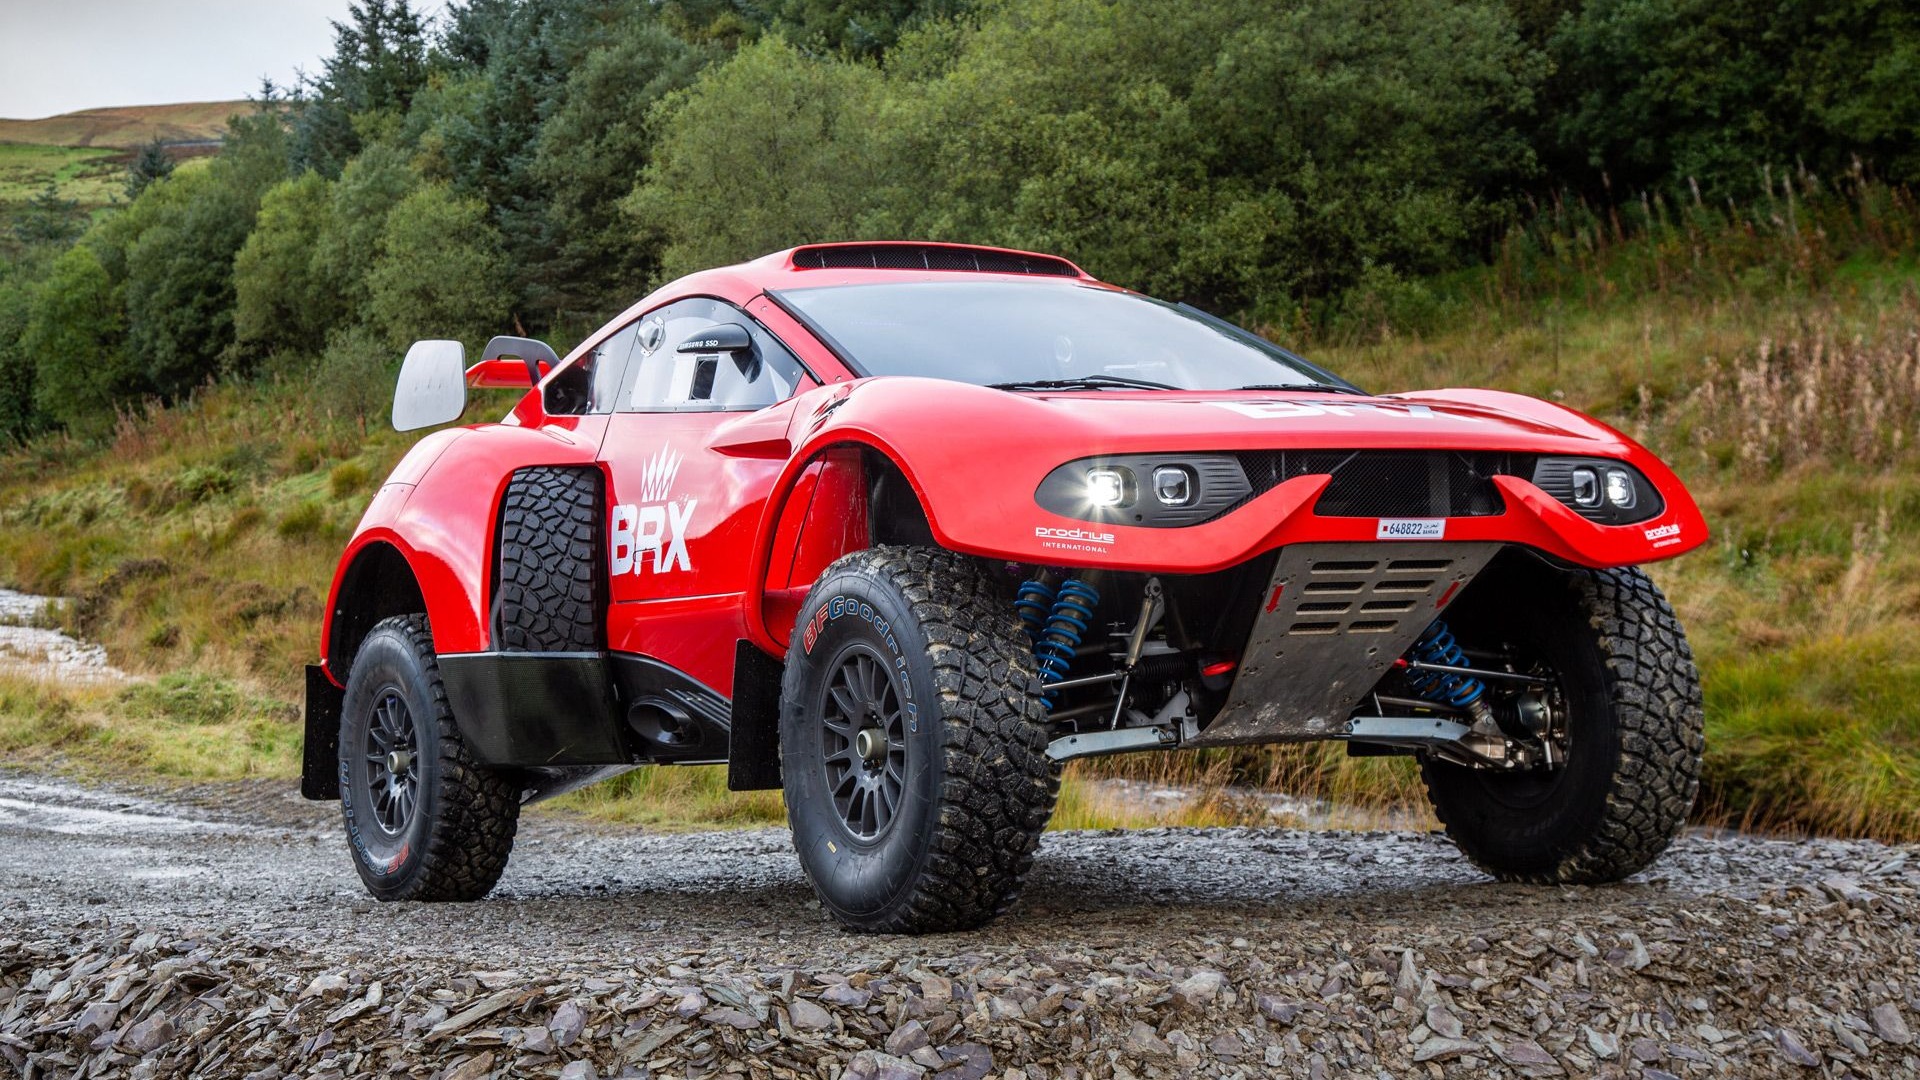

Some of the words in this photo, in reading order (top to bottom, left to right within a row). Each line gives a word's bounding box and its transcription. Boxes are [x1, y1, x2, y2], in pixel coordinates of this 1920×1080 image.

[705, 339, 719, 347] SSD
[1035, 526, 1115, 544] prodrive
[1390, 523, 1422, 535] 648822
[611, 498, 698, 577] BRX
[1042, 541, 1108, 554] INTERNATIONAL
[803, 595, 918, 733] BFGoodrich
